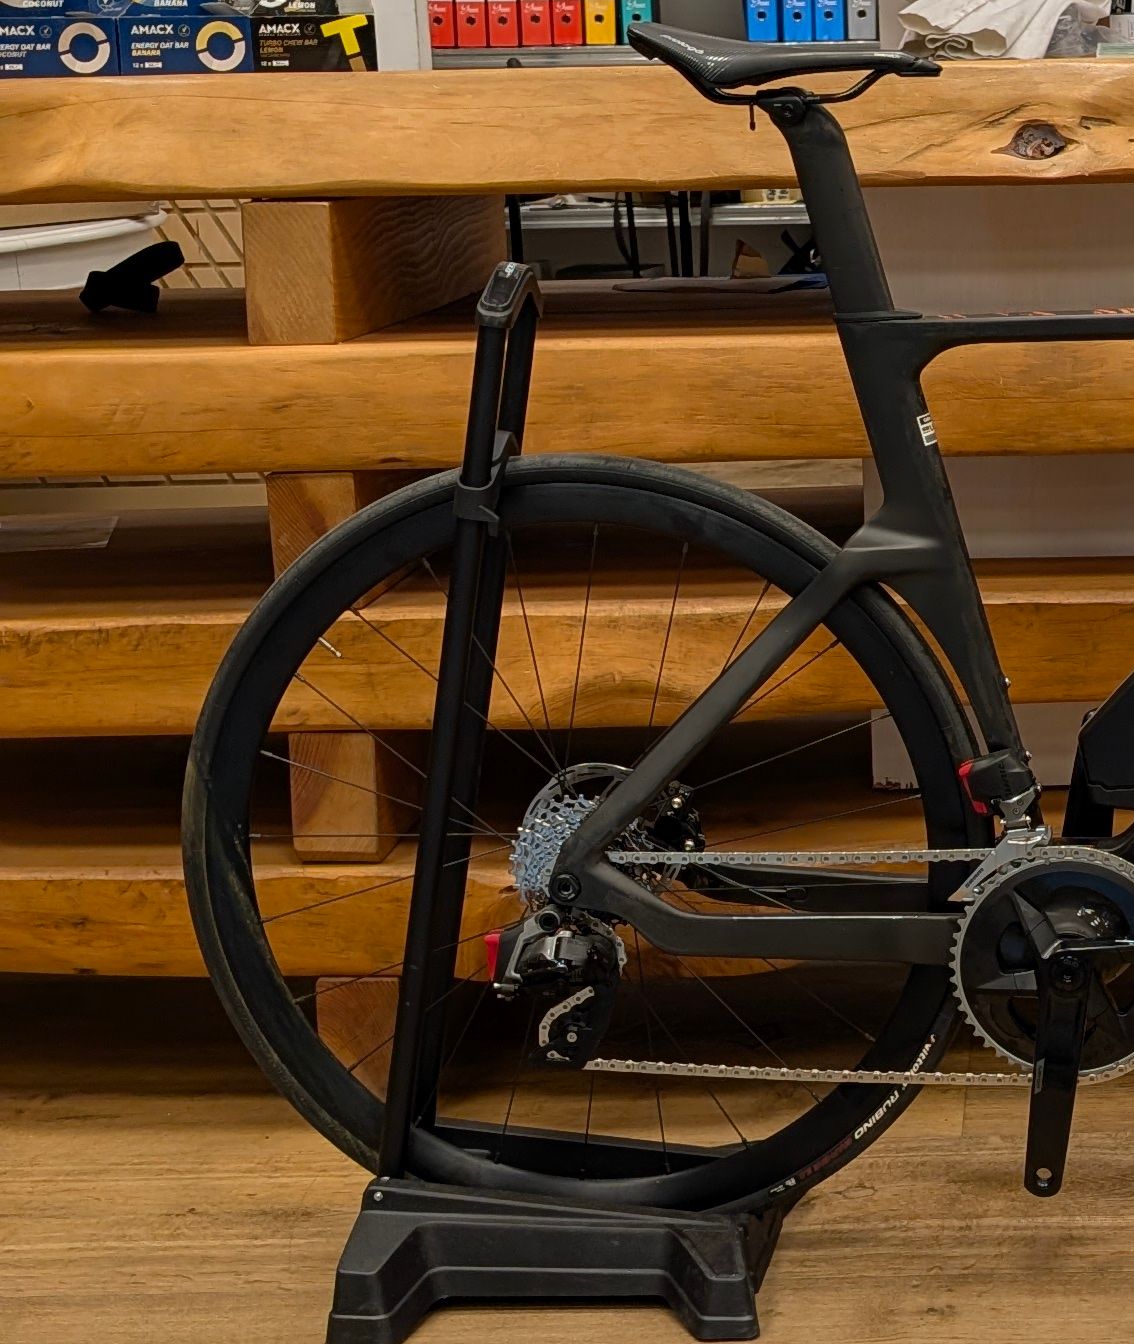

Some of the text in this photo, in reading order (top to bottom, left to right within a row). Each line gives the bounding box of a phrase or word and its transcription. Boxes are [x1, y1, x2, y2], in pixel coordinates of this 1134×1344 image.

[23, 0, 65, 8] COCONUT
[154, 0, 188, 7] BANANA
[288, 2, 316, 10] LEMON
[131, 23, 174, 36] AMACX
[259, 23, 301, 34] AMACX
[260, 39, 282, 47] TURBO
[854, 1089, 900, 1141] RUBINO
